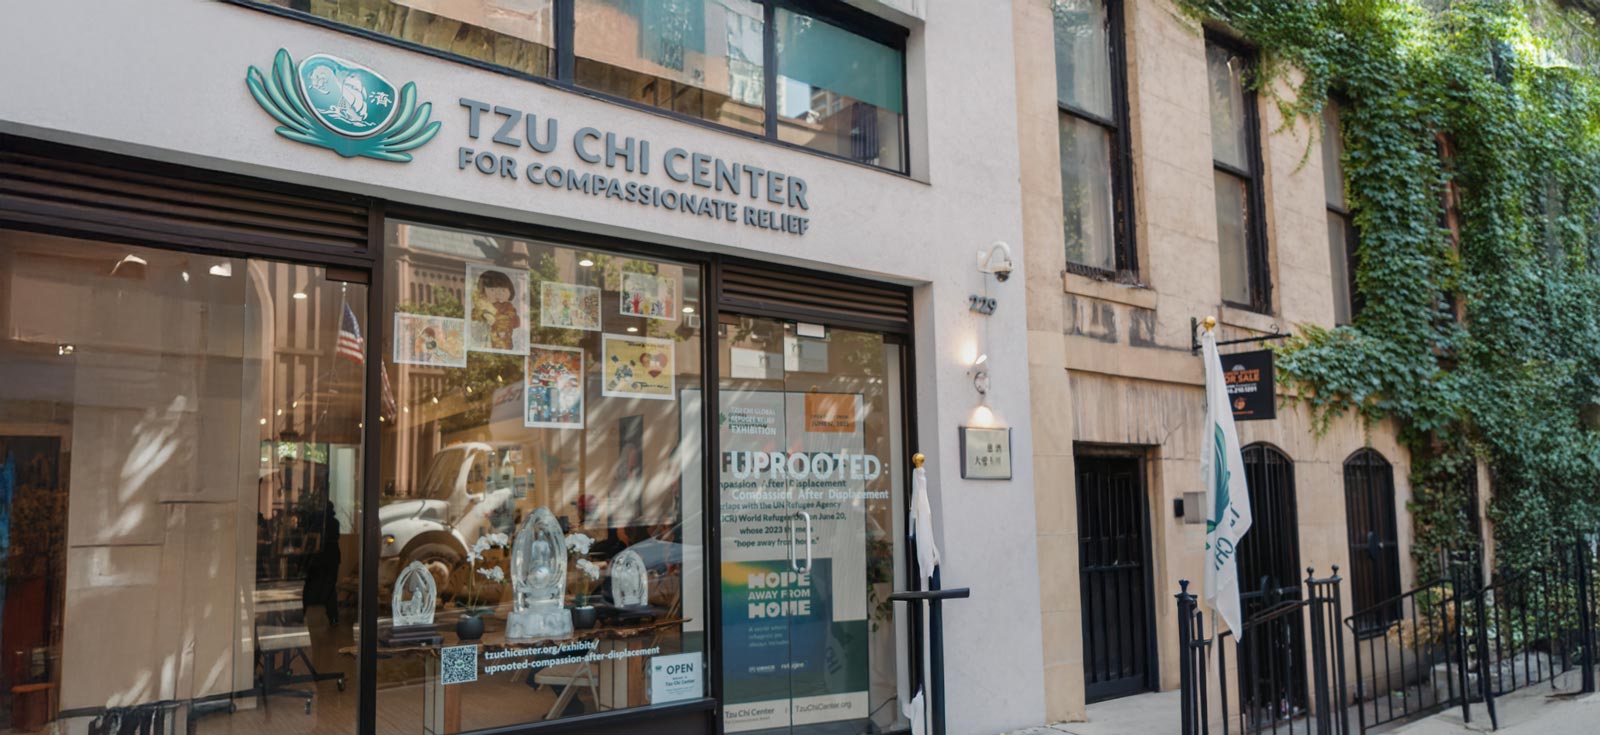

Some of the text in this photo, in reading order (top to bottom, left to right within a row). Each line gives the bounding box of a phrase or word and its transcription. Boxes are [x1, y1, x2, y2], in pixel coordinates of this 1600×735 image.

[458, 97, 810, 210] TZU CHI CENTER
[458, 146, 810, 236] FOR COMPASSIONATE RELIEF
[968, 294, 997, 316] 229
[731, 425, 776, 435] EXHIBITION
[732, 488, 889, 503] Compassion After Displacement
[741, 502, 758, 510] with
[759, 502, 771, 510] the
[773, 501, 785, 509] UN
[816, 501, 841, 509] Agency
[738, 514, 762, 522] World
[819, 513, 835, 521] June
[764, 526, 784, 534] 2023
[756, 540, 776, 548] away
[748, 572, 811, 589] HOPE
[748, 589, 811, 601] AWAY FROM
[748, 600, 811, 619] HOME
[484, 638, 600, 661] tzuchicenter.org/exhibits/
[484, 645, 661, 676] uprooted-compassion-after-displacement
[666, 662, 694, 675] OPEN
[725, 707, 775, 719] Tzu Chi Center
